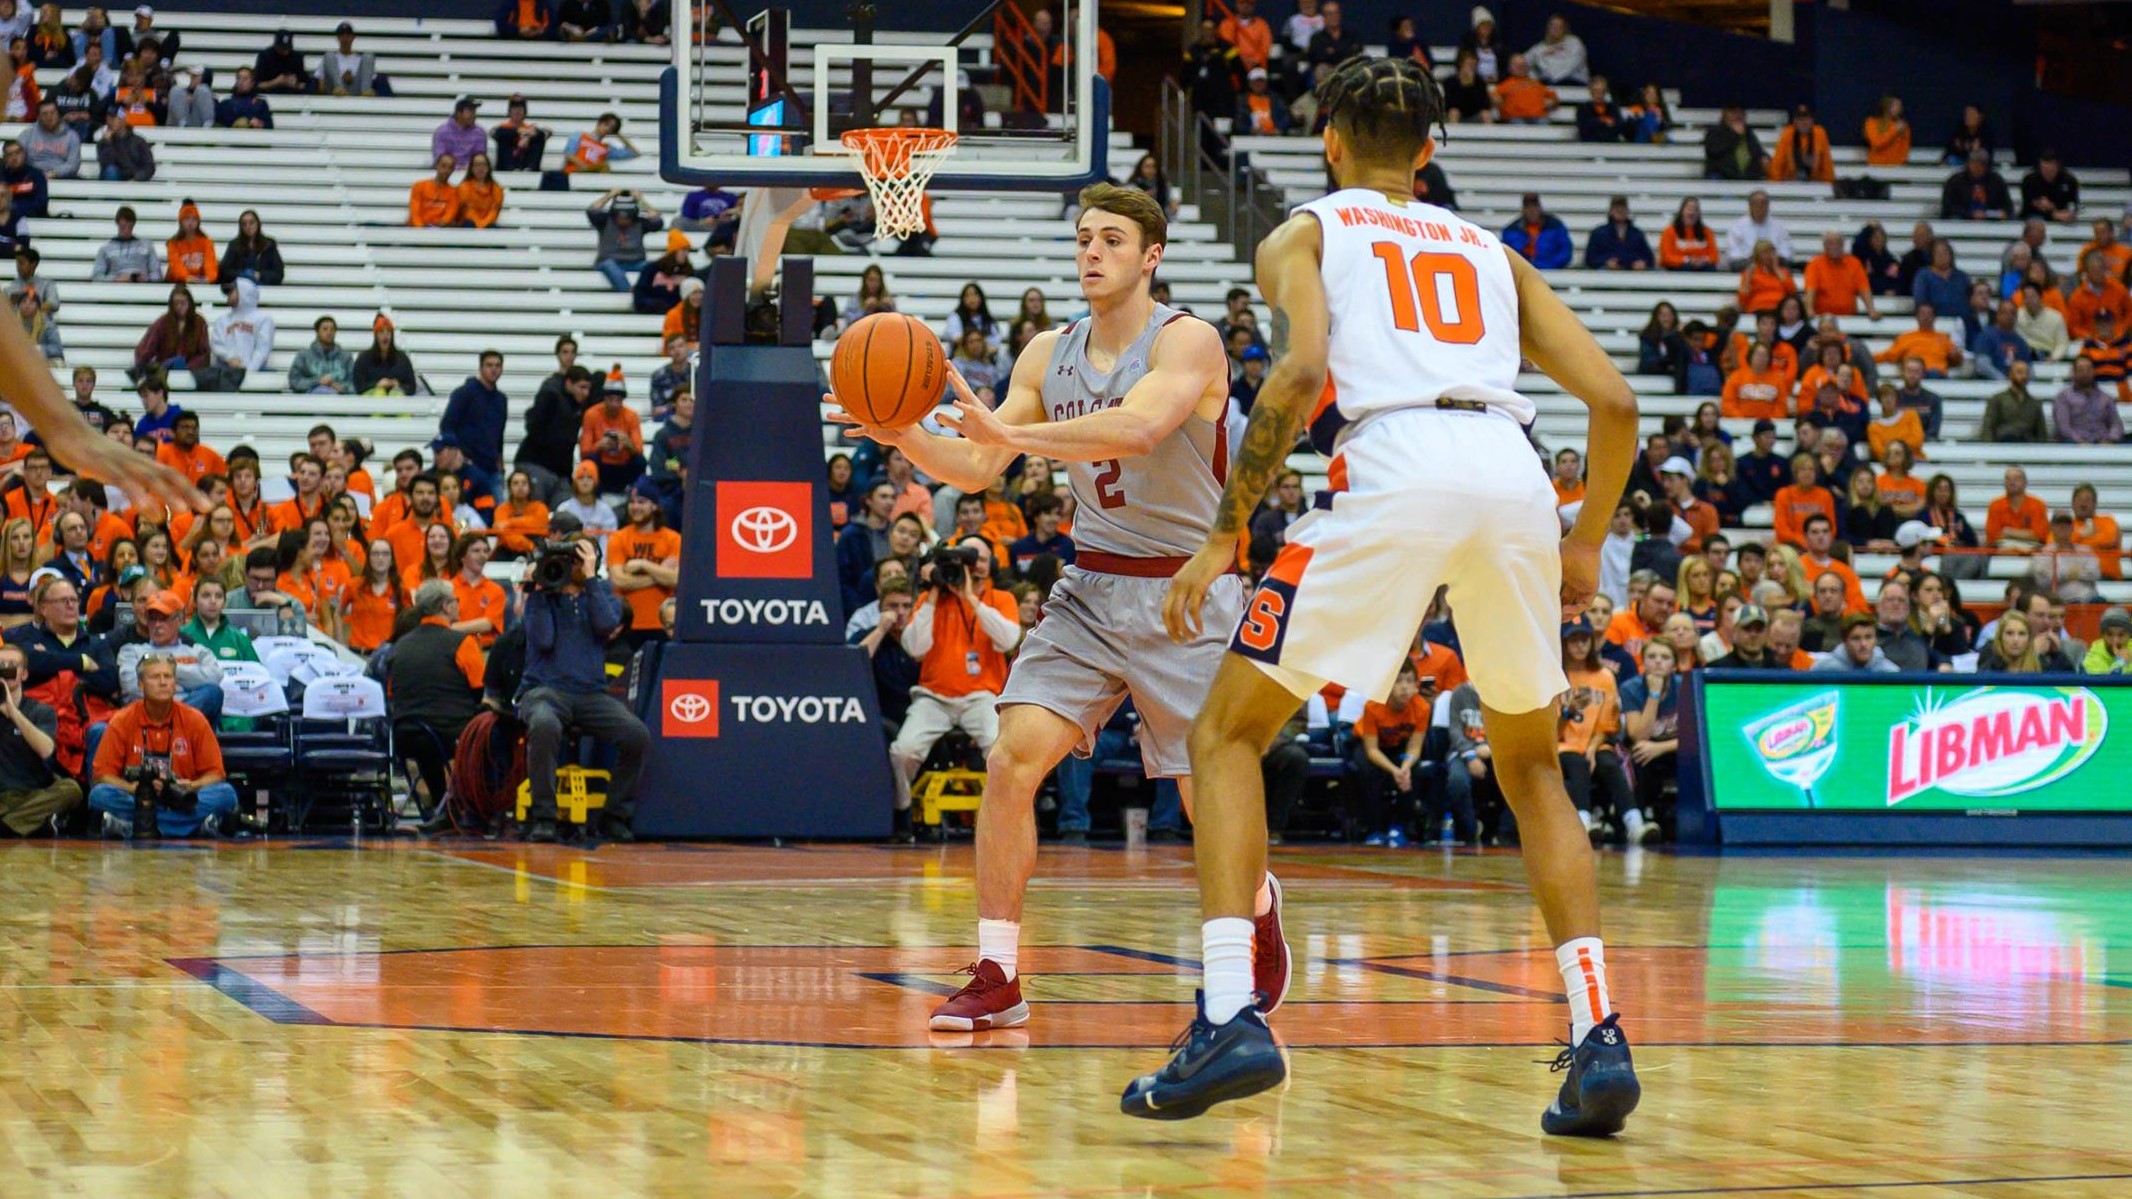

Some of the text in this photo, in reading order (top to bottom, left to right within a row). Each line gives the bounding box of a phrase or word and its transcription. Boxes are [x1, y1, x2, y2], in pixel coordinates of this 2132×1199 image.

[1335, 207, 1489, 249] WASHINGTON JR.
[1371, 241, 1486, 345] 10
[1092, 458, 1127, 509] 2
[700, 598, 830, 625] TOYOTA
[1240, 587, 1285, 651] S
[731, 695, 867, 723] TOYOTA
[1889, 696, 2085, 802] LIBMAN
